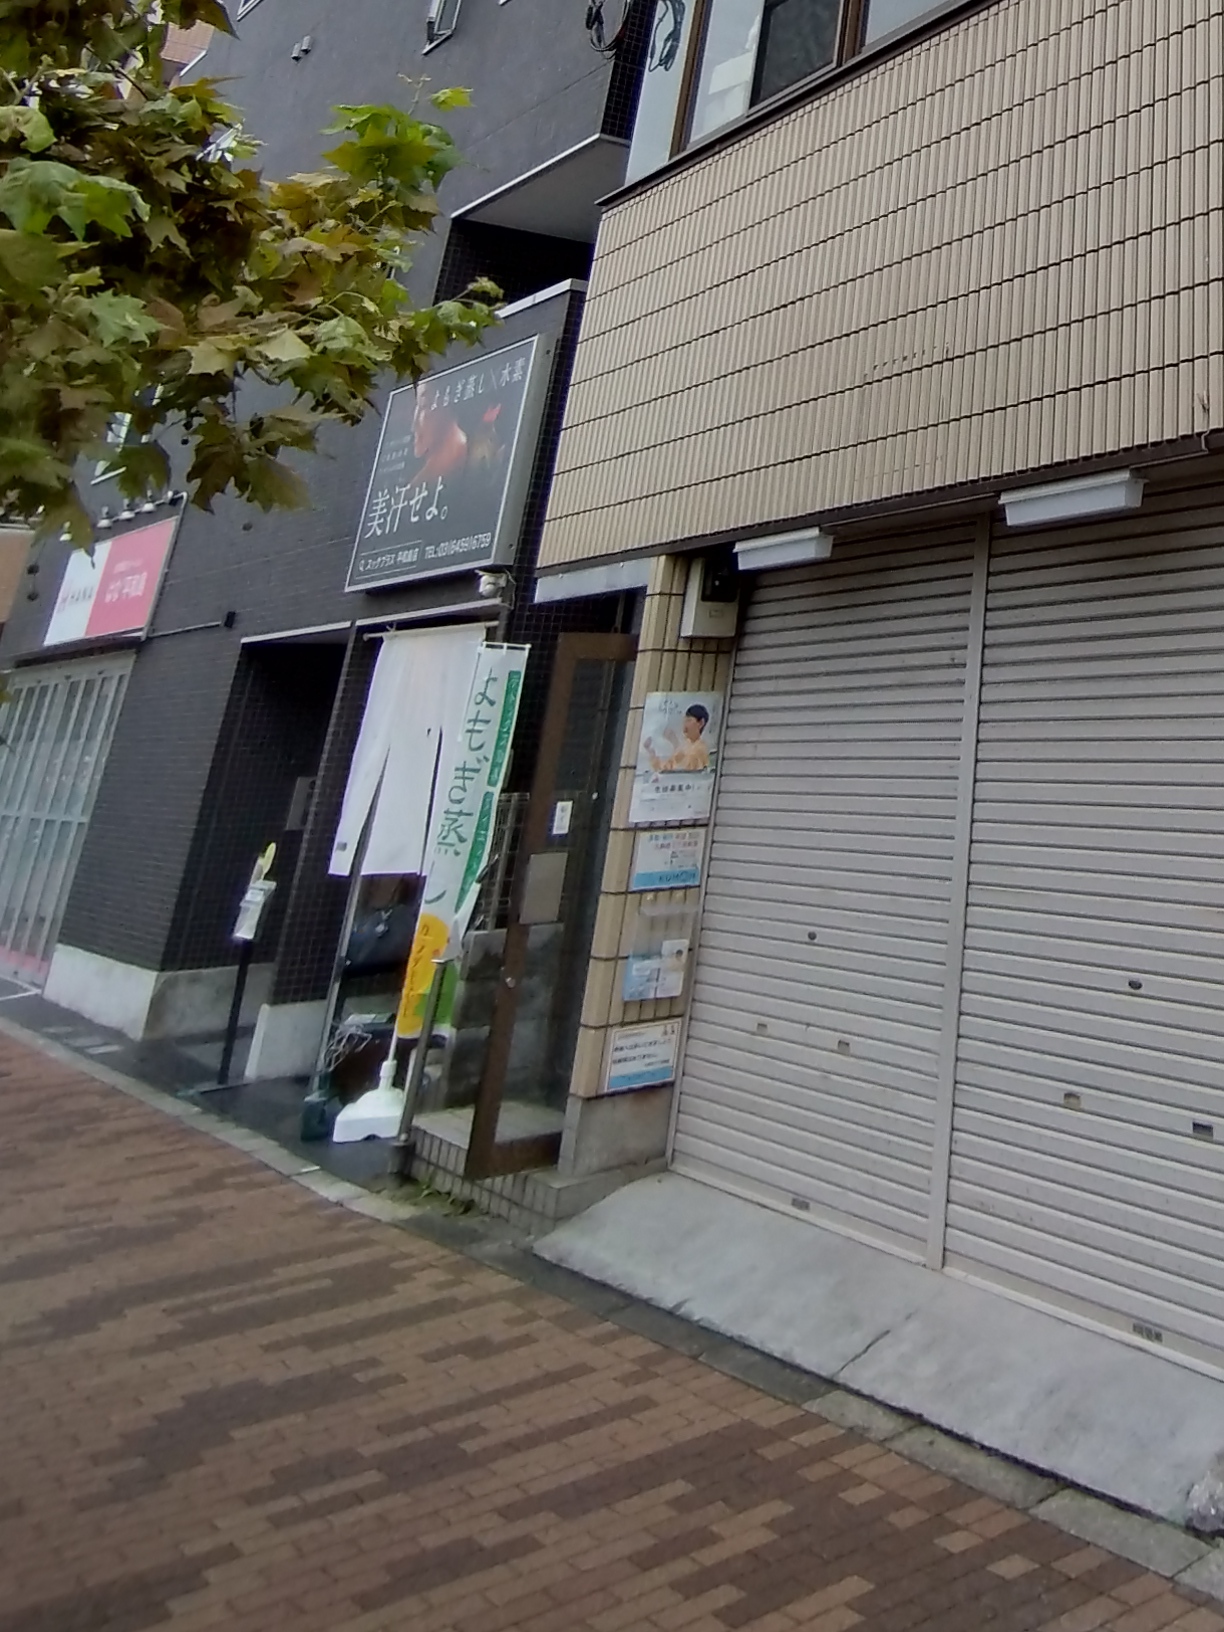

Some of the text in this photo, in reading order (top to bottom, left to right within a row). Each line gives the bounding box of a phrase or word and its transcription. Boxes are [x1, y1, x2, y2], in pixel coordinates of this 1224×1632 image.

[430, 357, 526, 410] よもぎ蒸し 水素
[364, 475, 449, 539] 美汗せよ。
[424, 667, 496, 905] よもぎ蒸し
